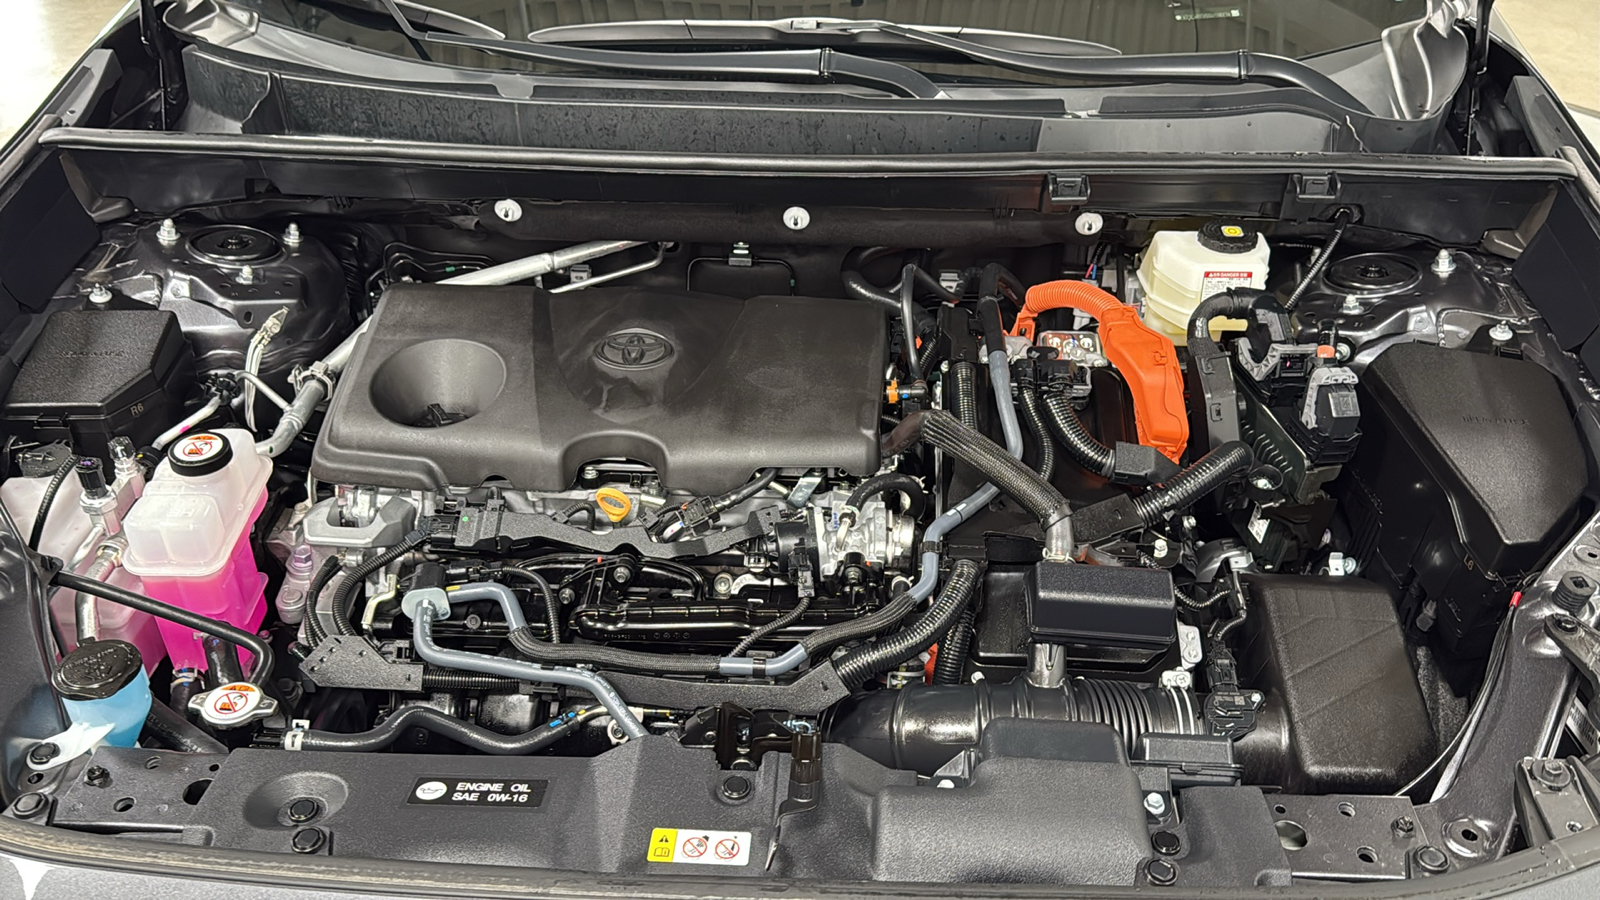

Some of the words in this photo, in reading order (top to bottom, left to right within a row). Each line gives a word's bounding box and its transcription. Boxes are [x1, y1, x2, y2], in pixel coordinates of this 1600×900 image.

[130, 403, 144, 416] R6
[456, 782, 504, 792] ENGINE
[510, 783, 531, 793] OIL
[452, 792, 480, 801] SAE
[487, 793, 528, 803] 0W-16
